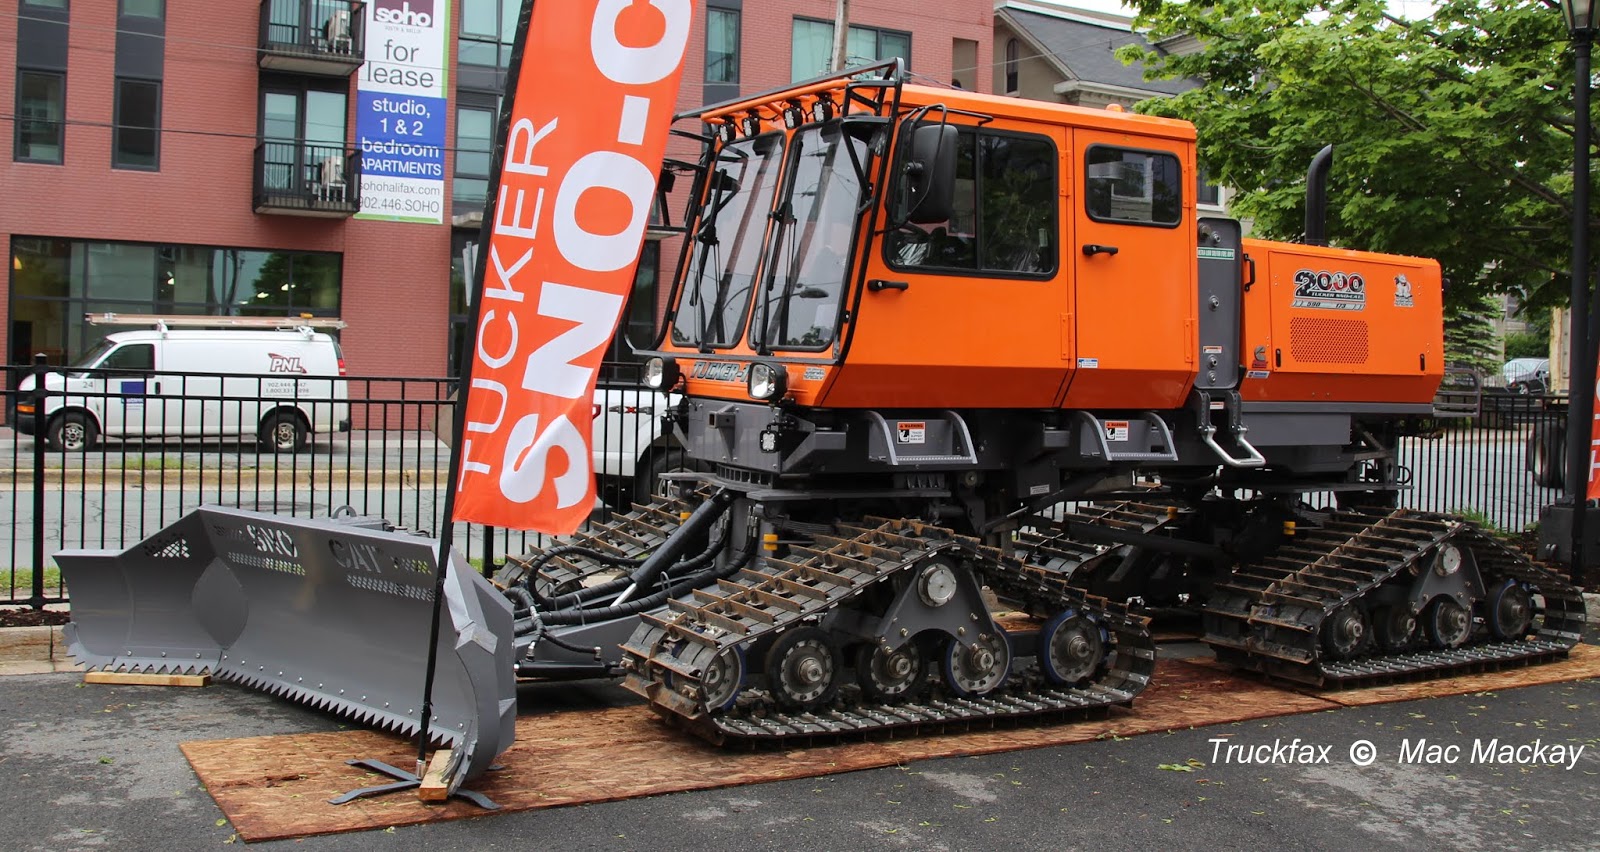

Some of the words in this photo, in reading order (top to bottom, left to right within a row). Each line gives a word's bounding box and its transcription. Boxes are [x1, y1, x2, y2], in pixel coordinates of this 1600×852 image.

[376, 2, 431, 27] soho
[384, 39, 419, 63] for
[367, 61, 434, 88] lease
[372, 99, 431, 118] studio,
[380, 118, 387, 133] 1
[395, 119, 408, 134] &
[412, 121, 424, 136] 2
[361, 137, 439, 157] bedroom
[361, 158, 441, 176] APARTMENTS
[1294, 270, 1364, 296] 2000
[458, 117, 558, 492] TUCKER
[269, 357, 303, 372] PNL
[246, 524, 299, 558] SNO
[328, 538, 382, 574] CAT
